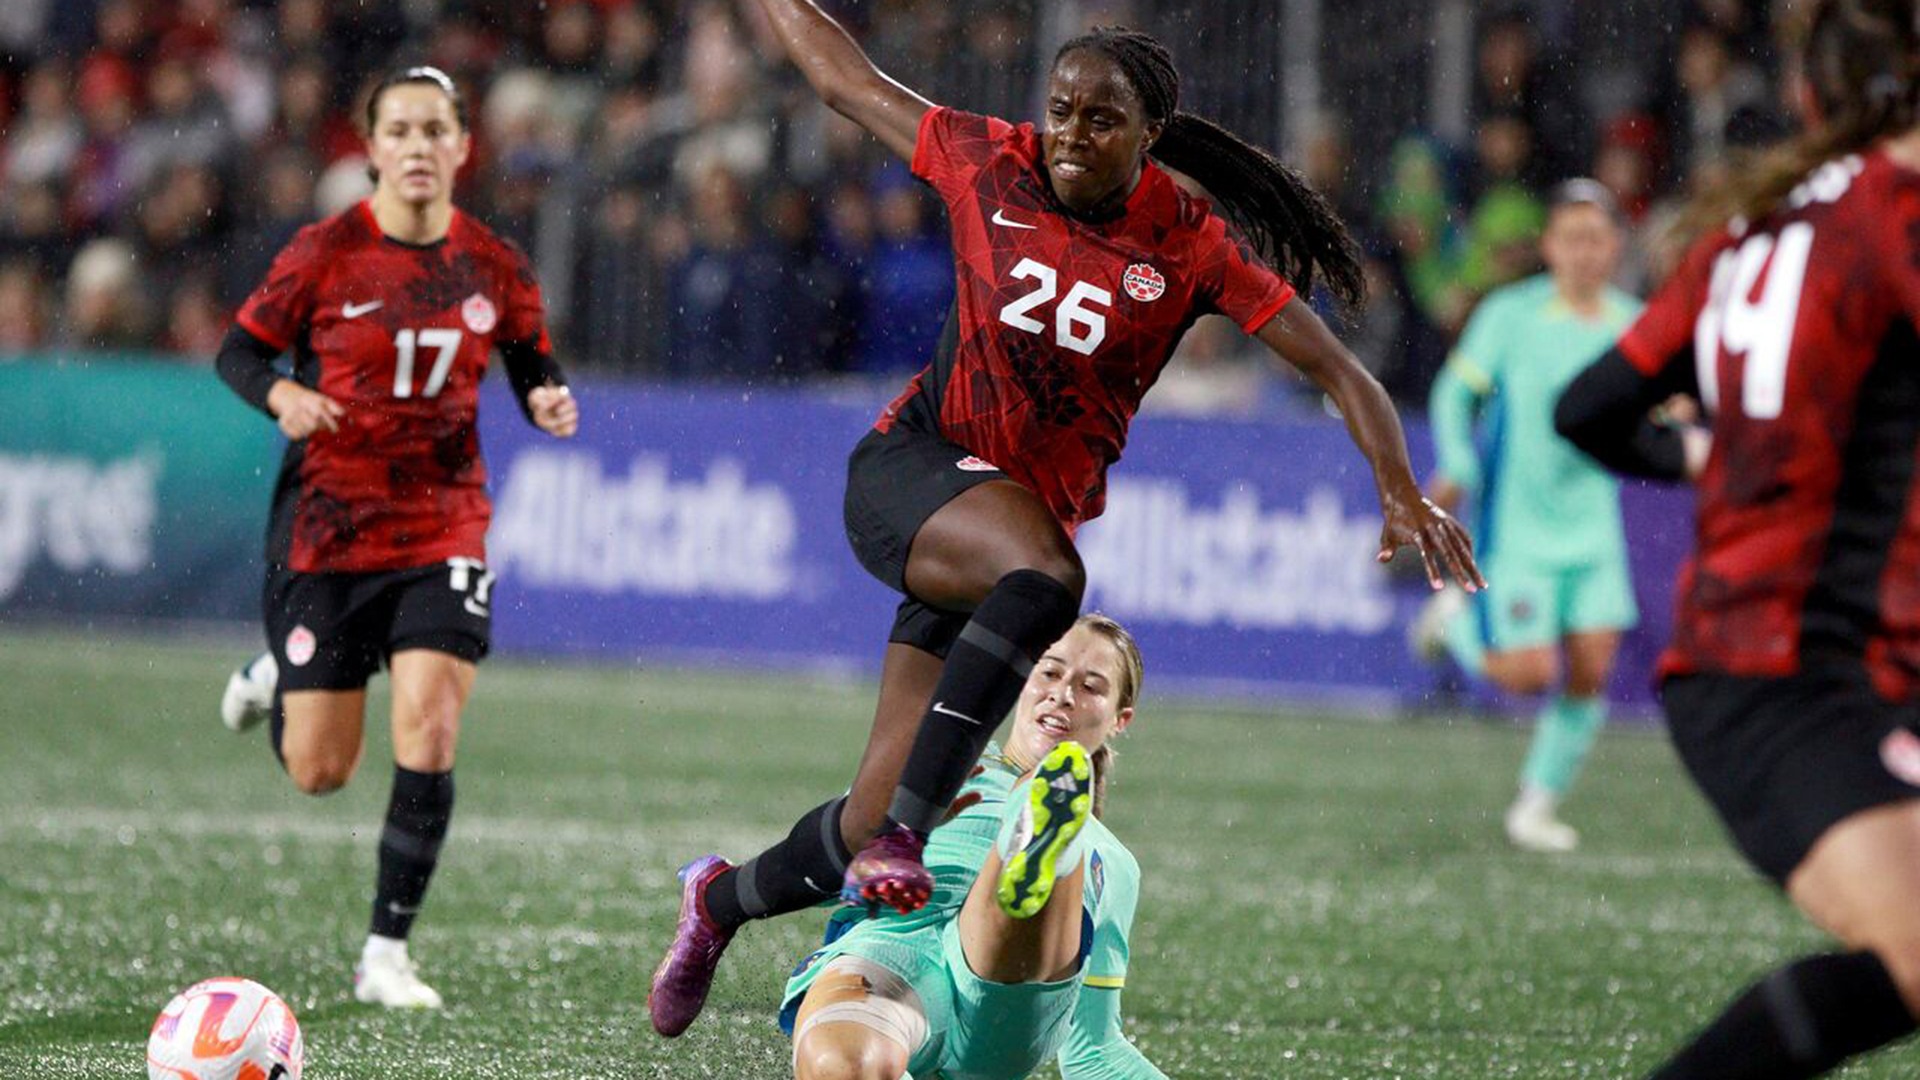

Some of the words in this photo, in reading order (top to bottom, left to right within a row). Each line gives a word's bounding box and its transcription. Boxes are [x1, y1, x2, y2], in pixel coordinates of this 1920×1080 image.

[999, 257, 1112, 356] 26
[1125, 273, 1163, 290] CANADA
[1695, 222, 1814, 420] 14
[393, 328, 463, 398] 17
[490, 449, 796, 601] Allstate
[1075, 475, 1396, 635] Allstate
[446, 556, 496, 605] 17
